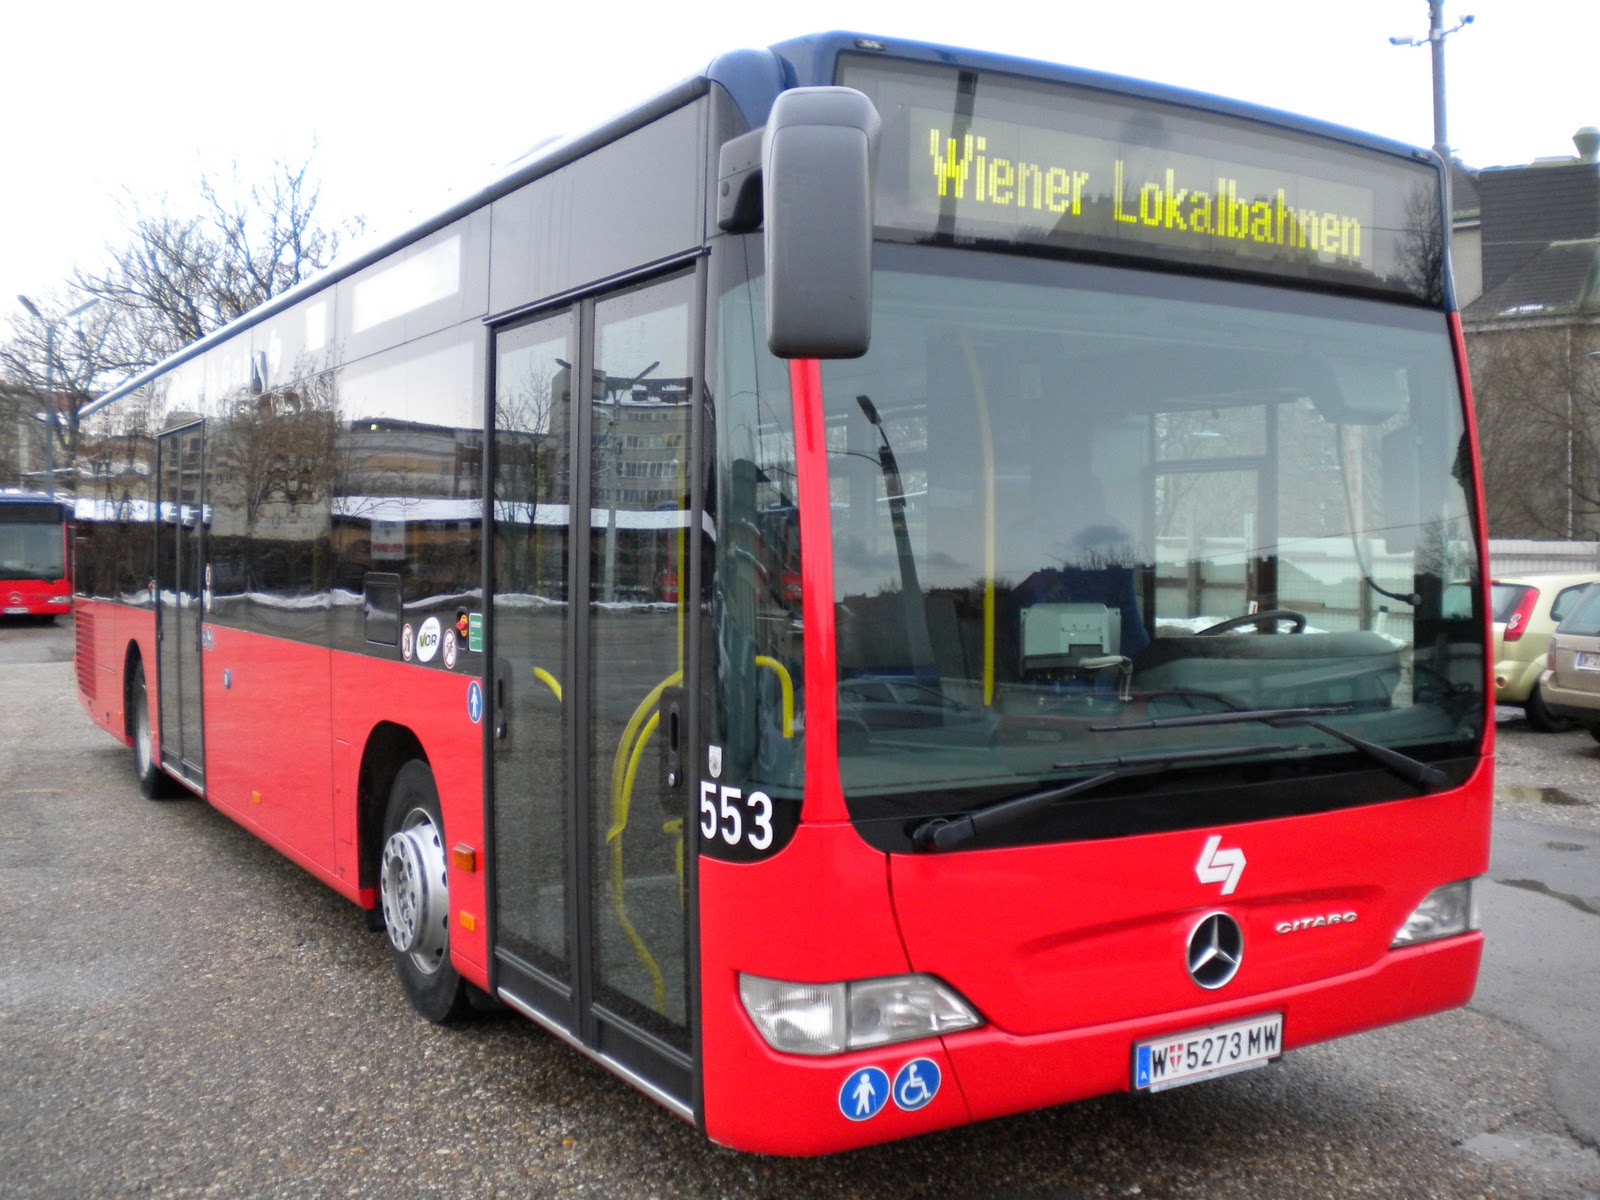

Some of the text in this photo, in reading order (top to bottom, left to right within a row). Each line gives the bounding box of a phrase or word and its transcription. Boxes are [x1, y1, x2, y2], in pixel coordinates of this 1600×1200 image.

[930, 129, 1361, 257] Wiener Lokalbahnen
[419, 632, 437, 647] VOR
[701, 781, 773, 850] 553
[1276, 911, 1358, 934] CITARO
[1187, 1031, 1241, 1069] 5273
[1248, 1023, 1278, 1056] MW
